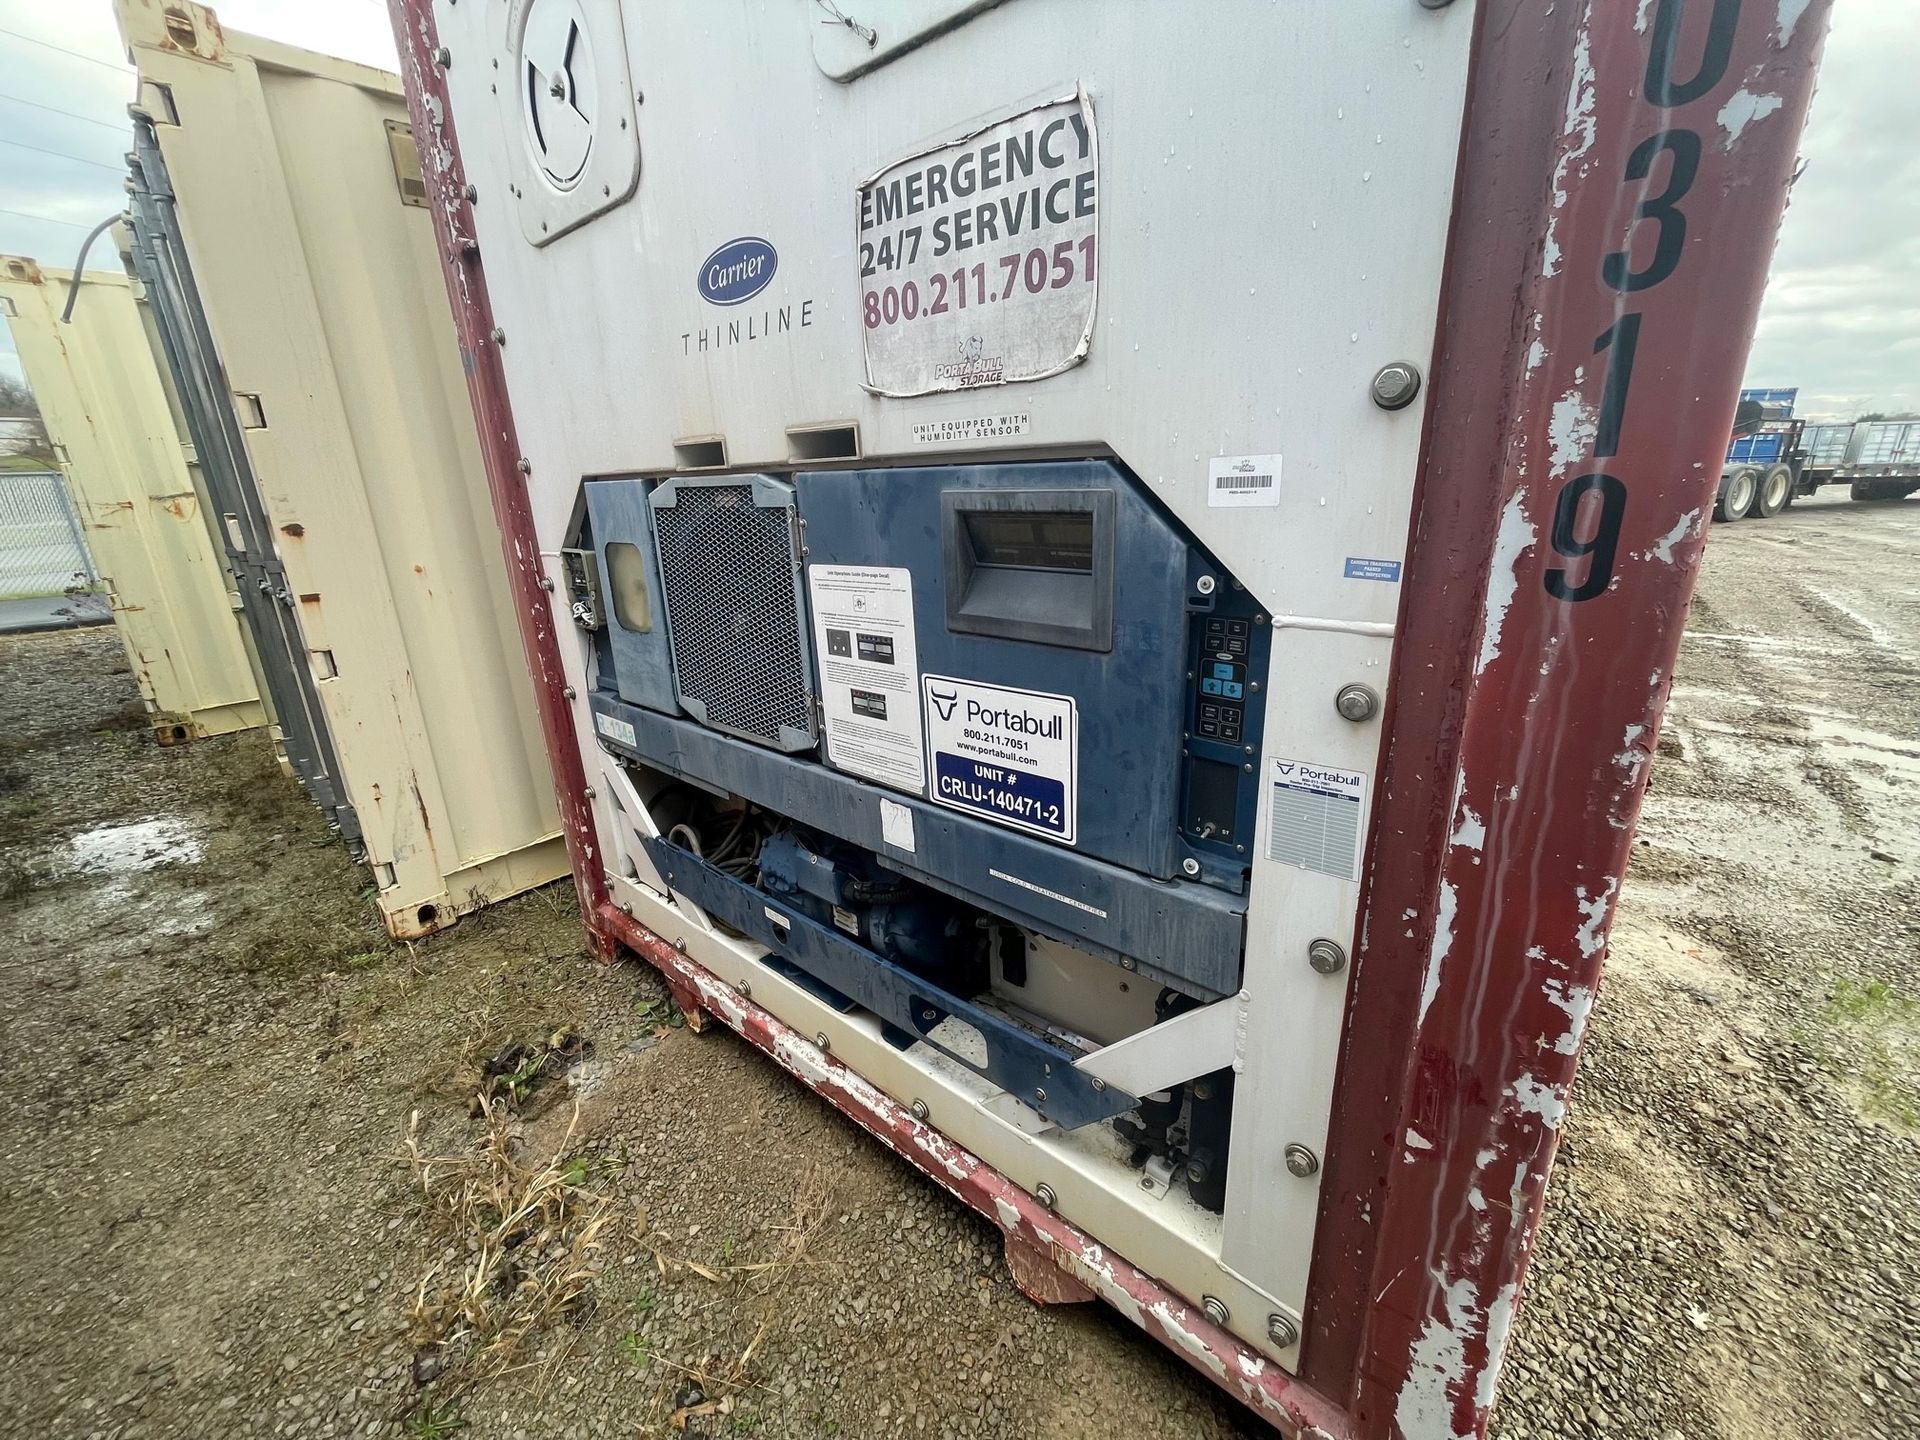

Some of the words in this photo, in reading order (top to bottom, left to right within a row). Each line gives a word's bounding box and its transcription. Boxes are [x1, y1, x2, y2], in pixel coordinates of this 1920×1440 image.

[861, 113, 1090, 231] EMERGENCY
[860, 226, 923, 278] 24/7
[933, 170, 1096, 257] SERVICE
[708, 254, 765, 290] Carrier
[864, 234, 1096, 329] 800.211.7051
[681, 299, 813, 356] THINLINE
[960, 371, 1003, 386] STORAGE
[913, 424, 936, 434] UNIT
[941, 418, 994, 431] EQUIPPED
[1000, 414, 1029, 425] WITH
[920, 430, 970, 442] HUMIDITY
[976, 425, 1021, 437] SENSOR
[967, 699, 1063, 741] Portabull
[957, 741, 1038, 767] www.portabull.com
[963, 728, 1029, 751] 800.211.7051
[974, 764, 1004, 783] UNIT
[1007, 773, 1018, 786] #
[1300, 767, 1360, 787] Portabull
[941, 775, 1060, 825] CRLU-140471-2
